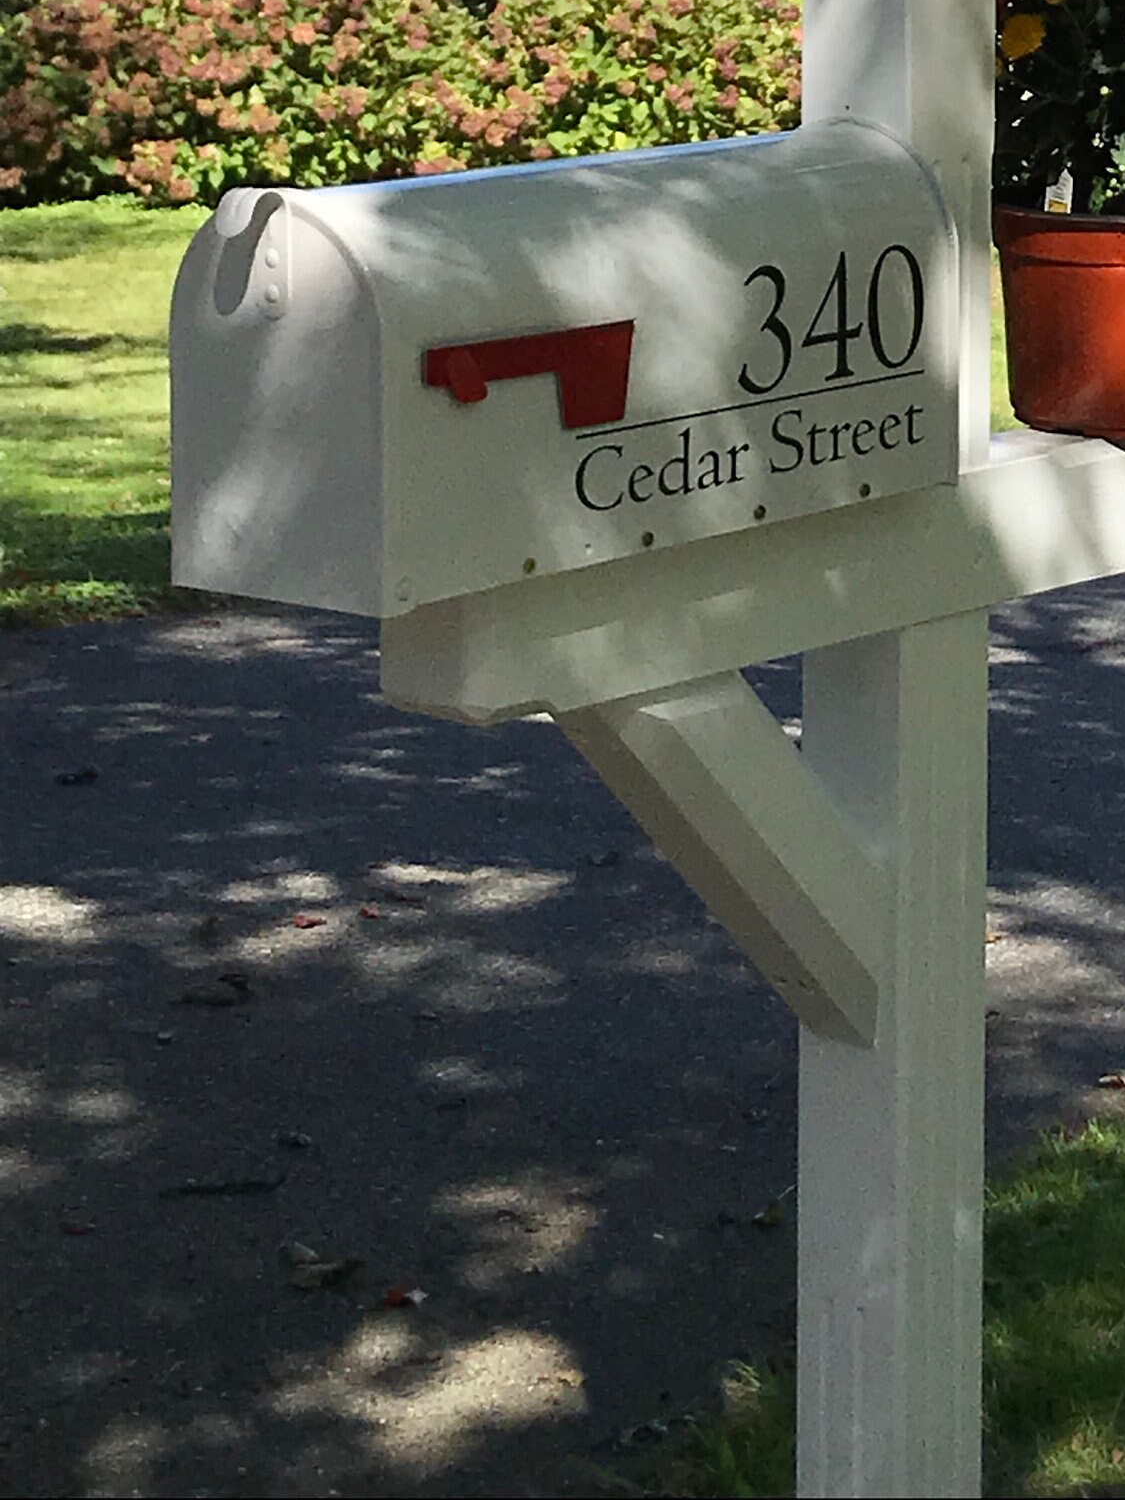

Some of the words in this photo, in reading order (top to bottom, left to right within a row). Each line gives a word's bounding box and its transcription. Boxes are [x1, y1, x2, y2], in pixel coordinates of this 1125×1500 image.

[736, 244, 925, 396] 340
[575, 427, 750, 512] Cedar
[768, 403, 925, 474] Street
